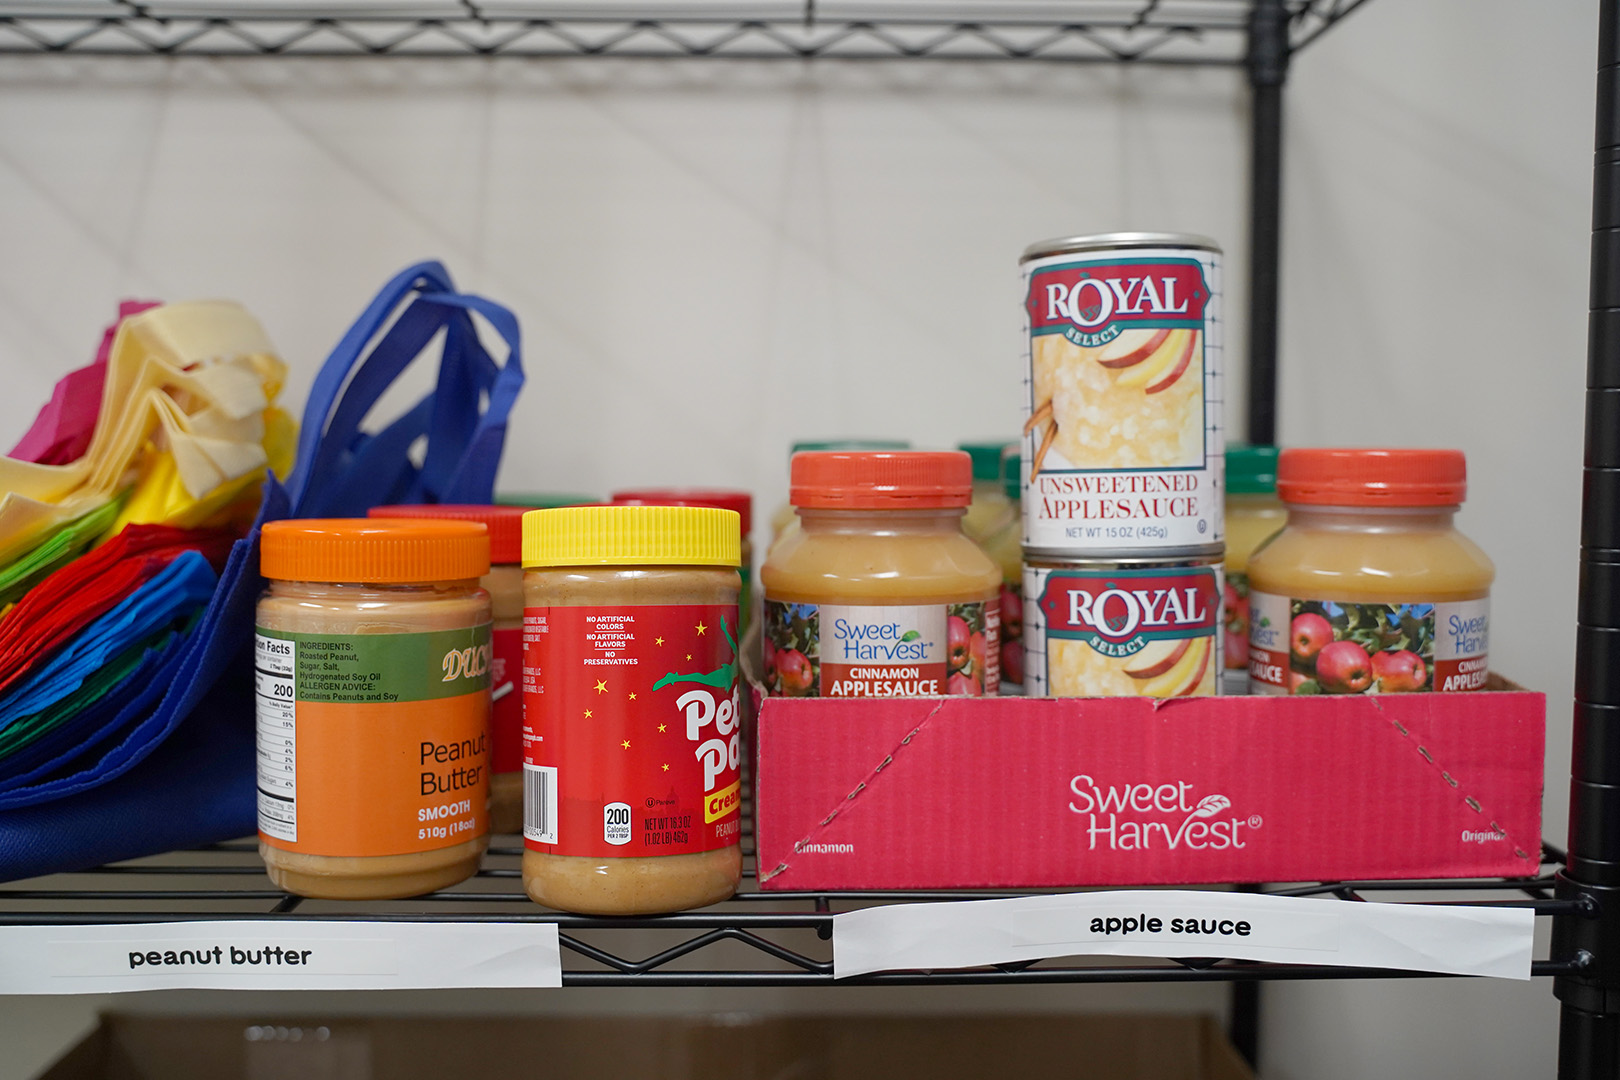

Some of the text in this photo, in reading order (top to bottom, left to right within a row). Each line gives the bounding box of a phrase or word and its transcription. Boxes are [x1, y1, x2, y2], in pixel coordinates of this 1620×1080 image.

[1046, 275, 1188, 327] ROYAL
[1066, 324, 1119, 346] SELECT
[1040, 474, 1198, 495] UNSWEETENED
[1039, 496, 1199, 520] APPLESAUCE
[1065, 526, 1168, 540] NET WT 15 OZ (425g)
[1066, 587, 1206, 637] ROYAL
[834, 619, 901, 641] Sweet
[266, 640, 291, 655] Facts
[299, 642, 354, 651] INGREDIENTS:
[1090, 635, 1145, 656] SELECT
[299, 651, 359, 662] Roasted Peanut,
[300, 661, 340, 671] Sugar, Salt,
[850, 667, 919, 679] CINNAMON
[299, 671, 381, 682] Hydrogenated Soy Oil
[273, 683, 294, 698] 200
[300, 681, 376, 691] ALLERGEN ADVICE:
[830, 679, 938, 697] APPLESAUCE
[300, 691, 399, 702] Contains Peanuts and Soy
[420, 731, 486, 766] Peanut
[420, 766, 483, 796] Butter
[1069, 774, 1194, 813] Sweet
[417, 800, 471, 822] SMOOTH
[606, 808, 629, 825] 200
[418, 817, 475, 840] 510g (18oz)
[606, 825, 629, 833] Calories
[644, 815, 692, 831] NET WT 16.3 OZ
[644, 830, 688, 846] (1.02 LB) 462g
[1089, 913, 1252, 936] apple sauce
[128, 945, 312, 969] peanut butter
